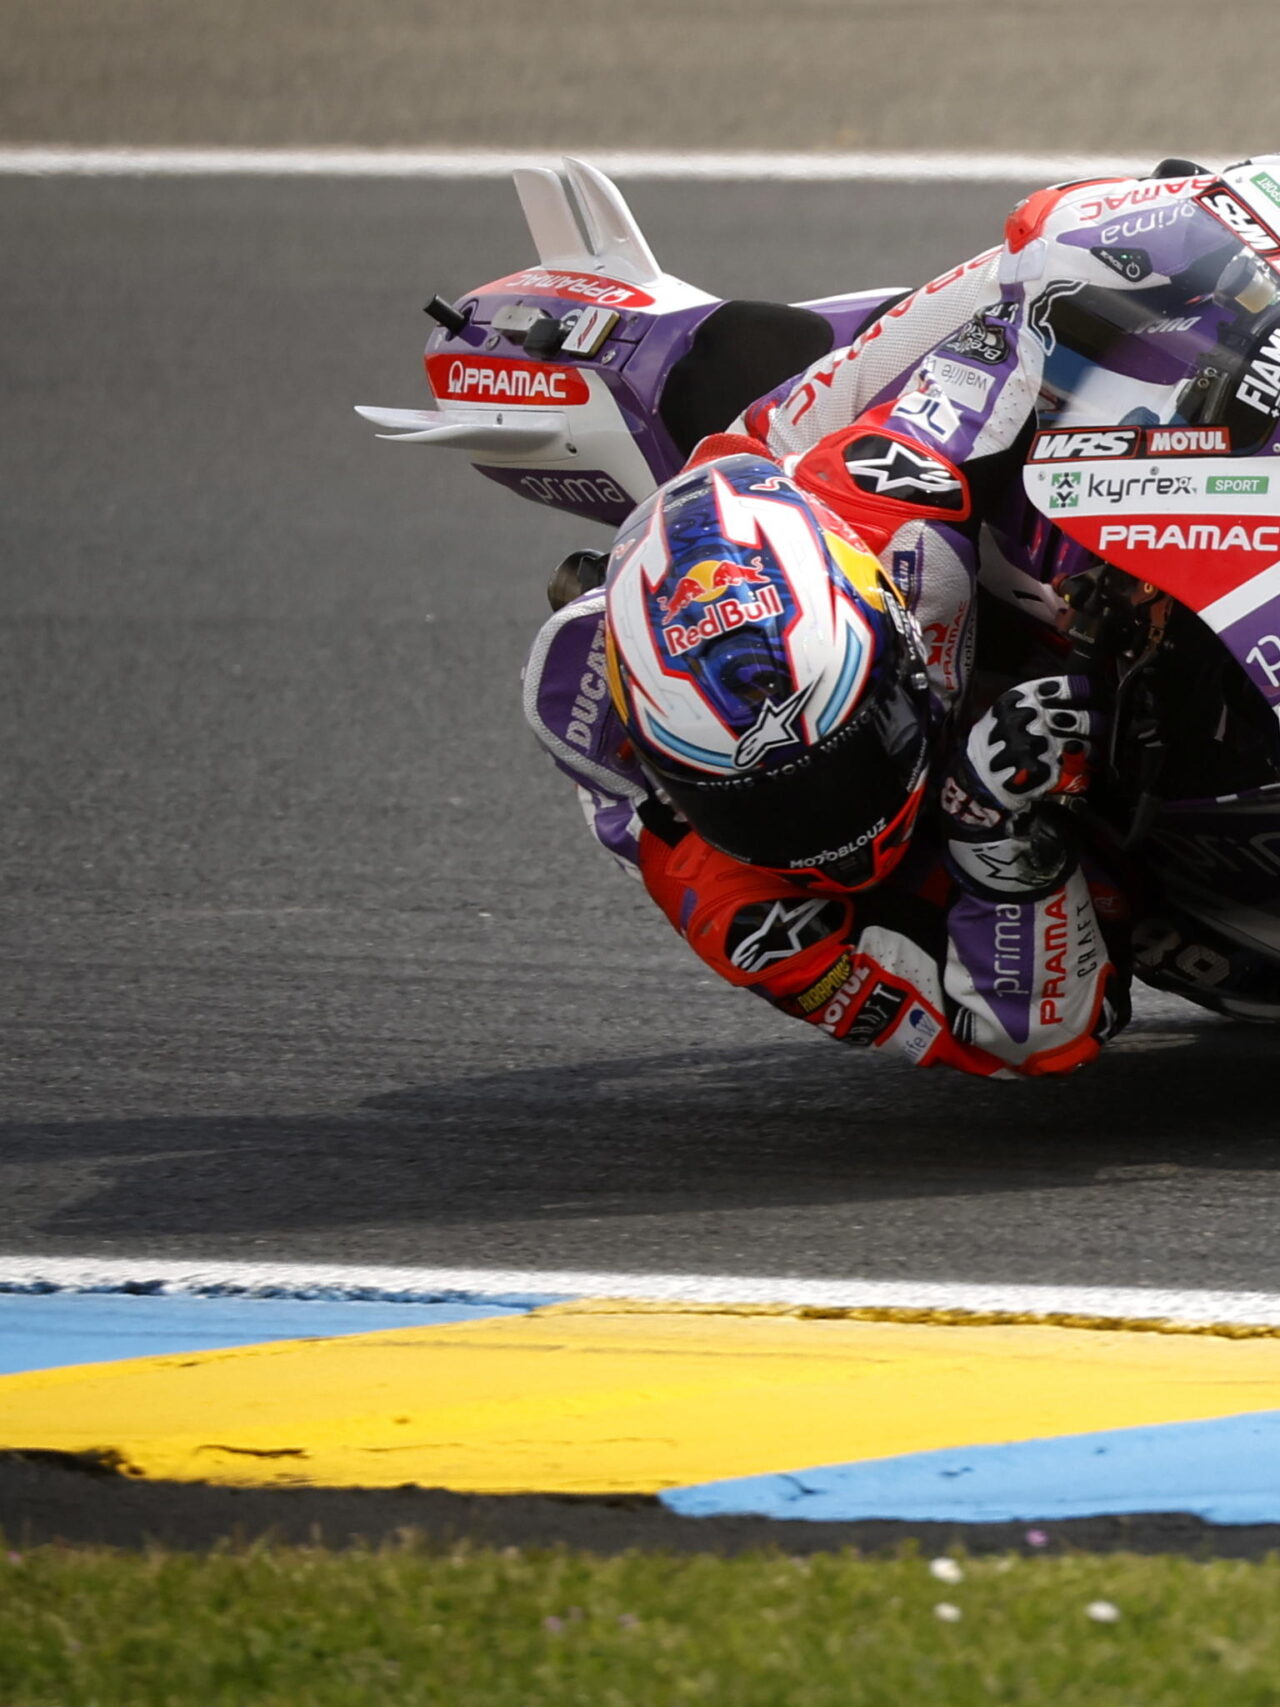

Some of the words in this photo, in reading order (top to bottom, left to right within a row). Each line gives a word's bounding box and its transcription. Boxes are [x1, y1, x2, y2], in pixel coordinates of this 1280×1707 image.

[1079, 175, 1221, 222] RAMAC
[1201, 194, 1280, 250] WRS
[506, 272, 615, 298] PRAMAC
[463, 368, 566, 398] PRAMAC
[1032, 431, 1136, 460] WRS
[1151, 431, 1226, 451] MOTUL
[520, 476, 625, 504] prima
[1088, 473, 1193, 503] kyrrex
[1215, 479, 1260, 492] SPORT
[1099, 525, 1280, 551] PRAMAC
[663, 605, 722, 656] Red
[719, 584, 784, 631] Bull
[766, 755, 812, 779] YOU
[820, 702, 879, 754] WING
[789, 817, 888, 869] MOTOBLOUZ
[994, 904, 1029, 997] prima
